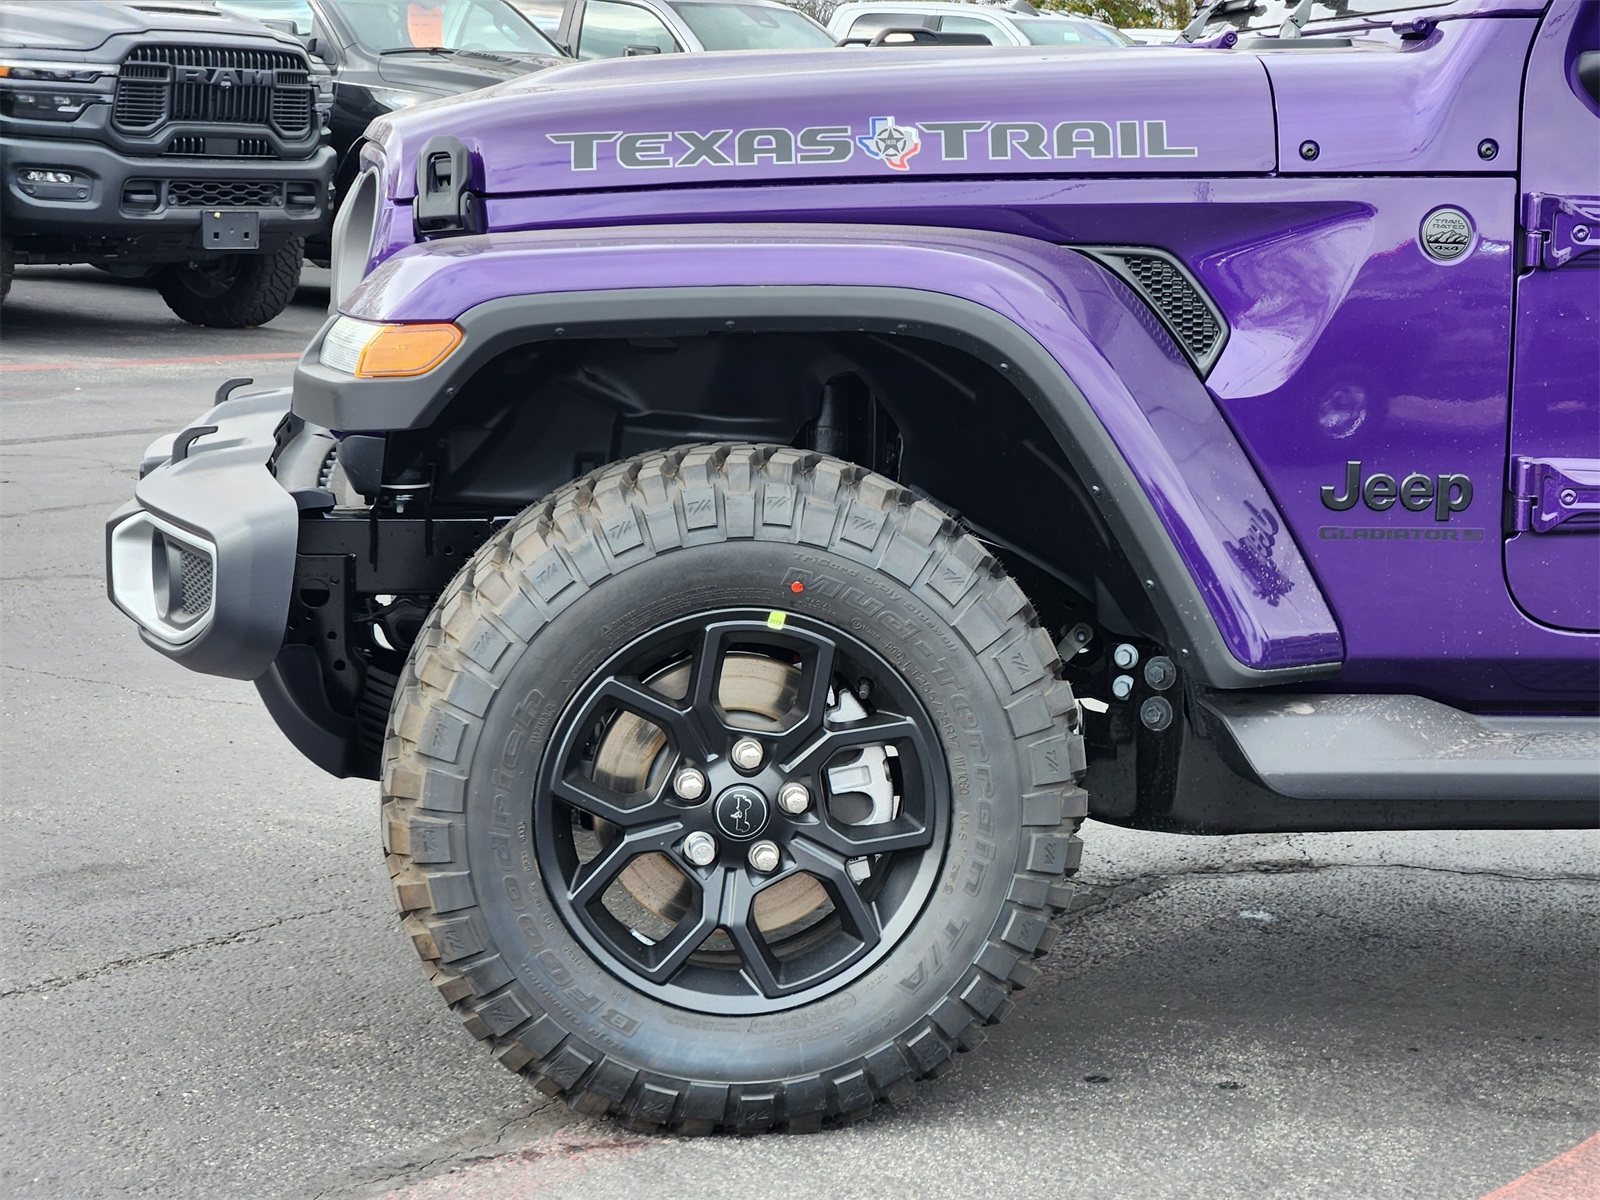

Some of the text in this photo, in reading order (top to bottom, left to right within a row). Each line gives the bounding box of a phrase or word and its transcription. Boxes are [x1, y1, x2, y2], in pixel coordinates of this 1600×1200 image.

[176, 66, 273, 86] RAM
[546, 120, 1199, 171] TEXAS TRAIL
[1320, 460, 1474, 522] Jeep
[1318, 527, 1459, 541] GLADIATOR
[792, 552, 860, 578] TriGard
[904, 601, 960, 653] Sidewall
[780, 566, 997, 898] Mud-Terrain
[895, 918, 970, 996] T/A
[957, 812, 970, 843] M+S
[487, 688, 645, 1038] BFGoodrich
